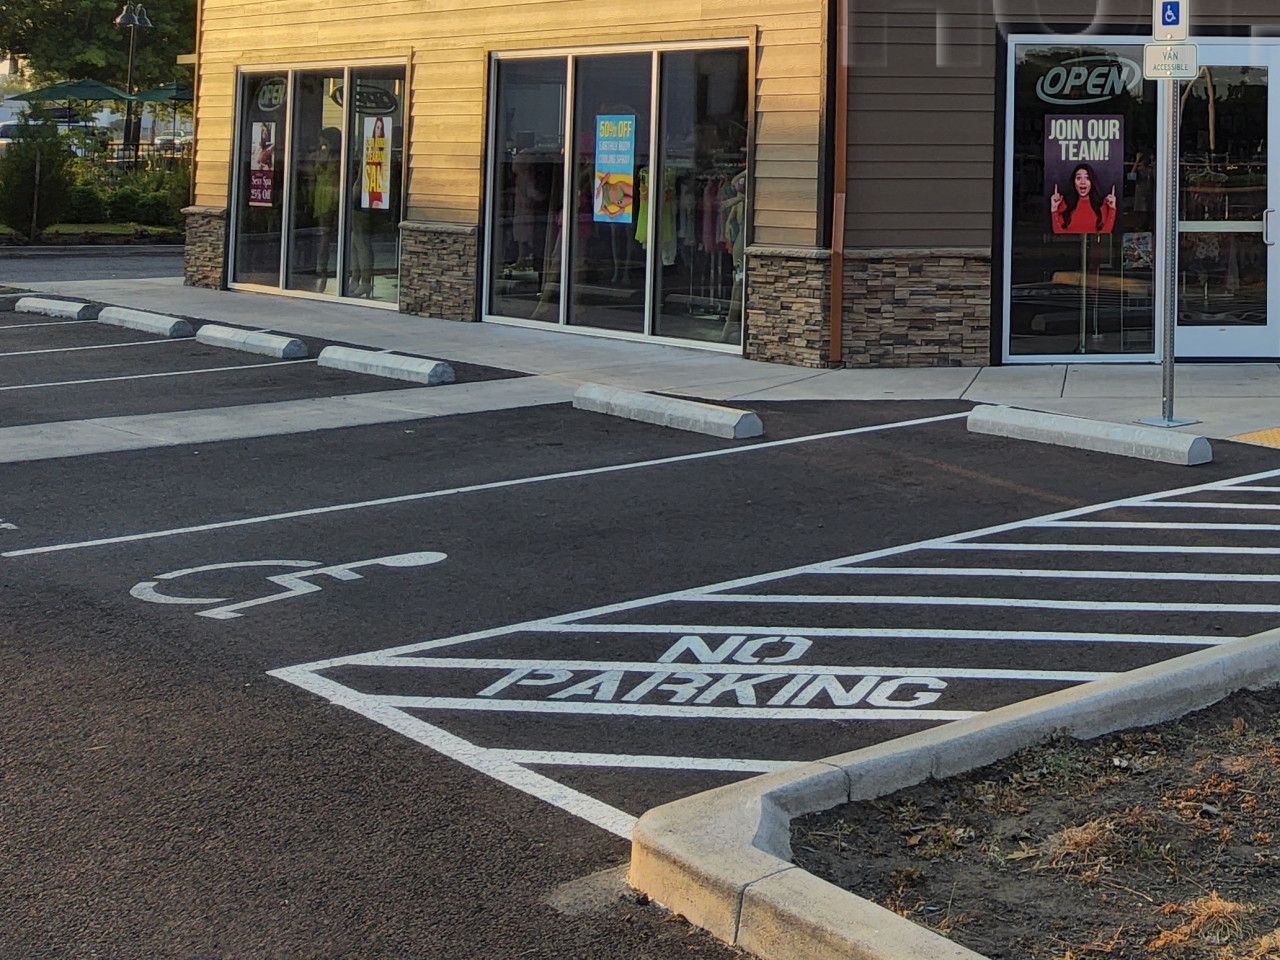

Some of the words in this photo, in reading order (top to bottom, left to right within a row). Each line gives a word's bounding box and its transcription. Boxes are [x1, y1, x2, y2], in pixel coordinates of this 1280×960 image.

[1162, 51, 1179, 61] VAN
[1152, 63, 1188, 71] ACCESSIBLE
[1043, 66, 1130, 95] OPEN
[1048, 119, 1083, 140] JOIN
[1087, 119, 1120, 140] OUR
[1058, 140, 1110, 161] TEAM!
[656, 634, 814, 664] NO
[476, 666, 949, 708] PARKING
